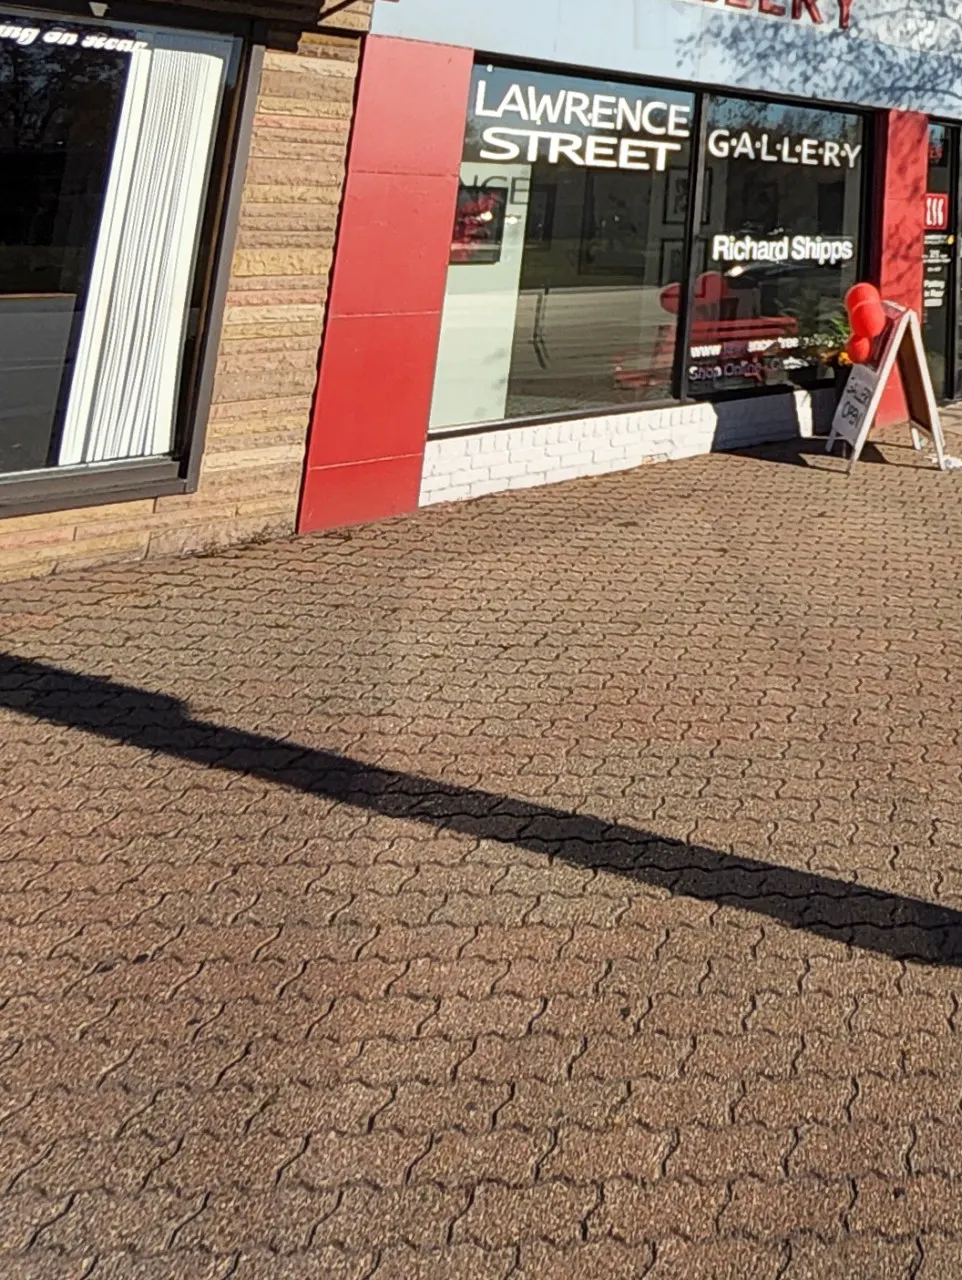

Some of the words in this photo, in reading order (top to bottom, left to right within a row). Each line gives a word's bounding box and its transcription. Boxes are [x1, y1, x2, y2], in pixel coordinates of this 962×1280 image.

[475, 80, 690, 137] LAWRENCE
[479, 126, 681, 171] STREET
[712, 234, 789, 261] Richard
[791, 234, 853, 265] Shipps
[689, 365, 723, 381] Shop
